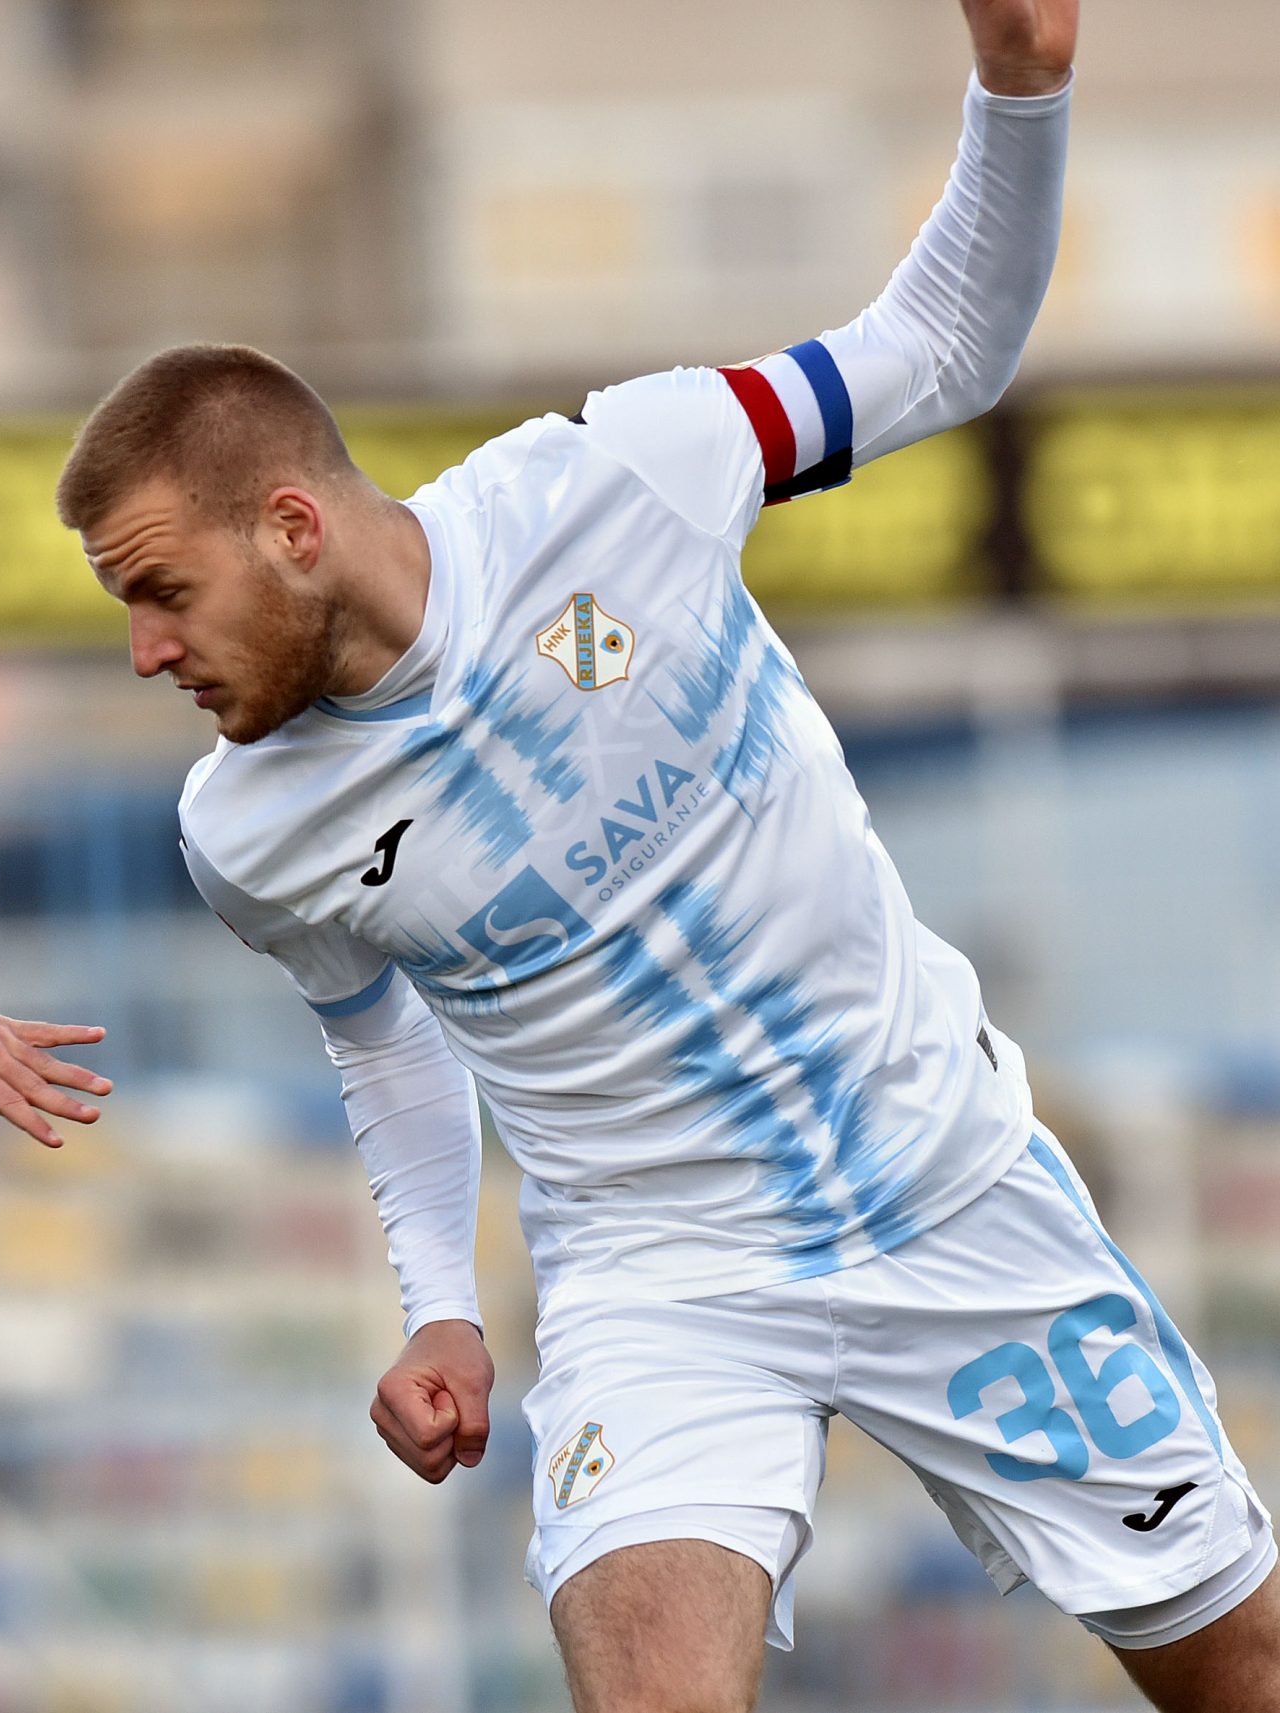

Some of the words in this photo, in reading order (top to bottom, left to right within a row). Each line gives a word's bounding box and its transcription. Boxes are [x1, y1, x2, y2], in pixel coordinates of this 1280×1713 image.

[543, 624, 571, 652] HNK
[577, 601, 593, 680] RIJEKA
[565, 759, 696, 886] SAVA
[598, 782, 710, 902] OSIGURANJE
[946, 1293, 1181, 1482] 36
[552, 1447, 571, 1473] HNK
